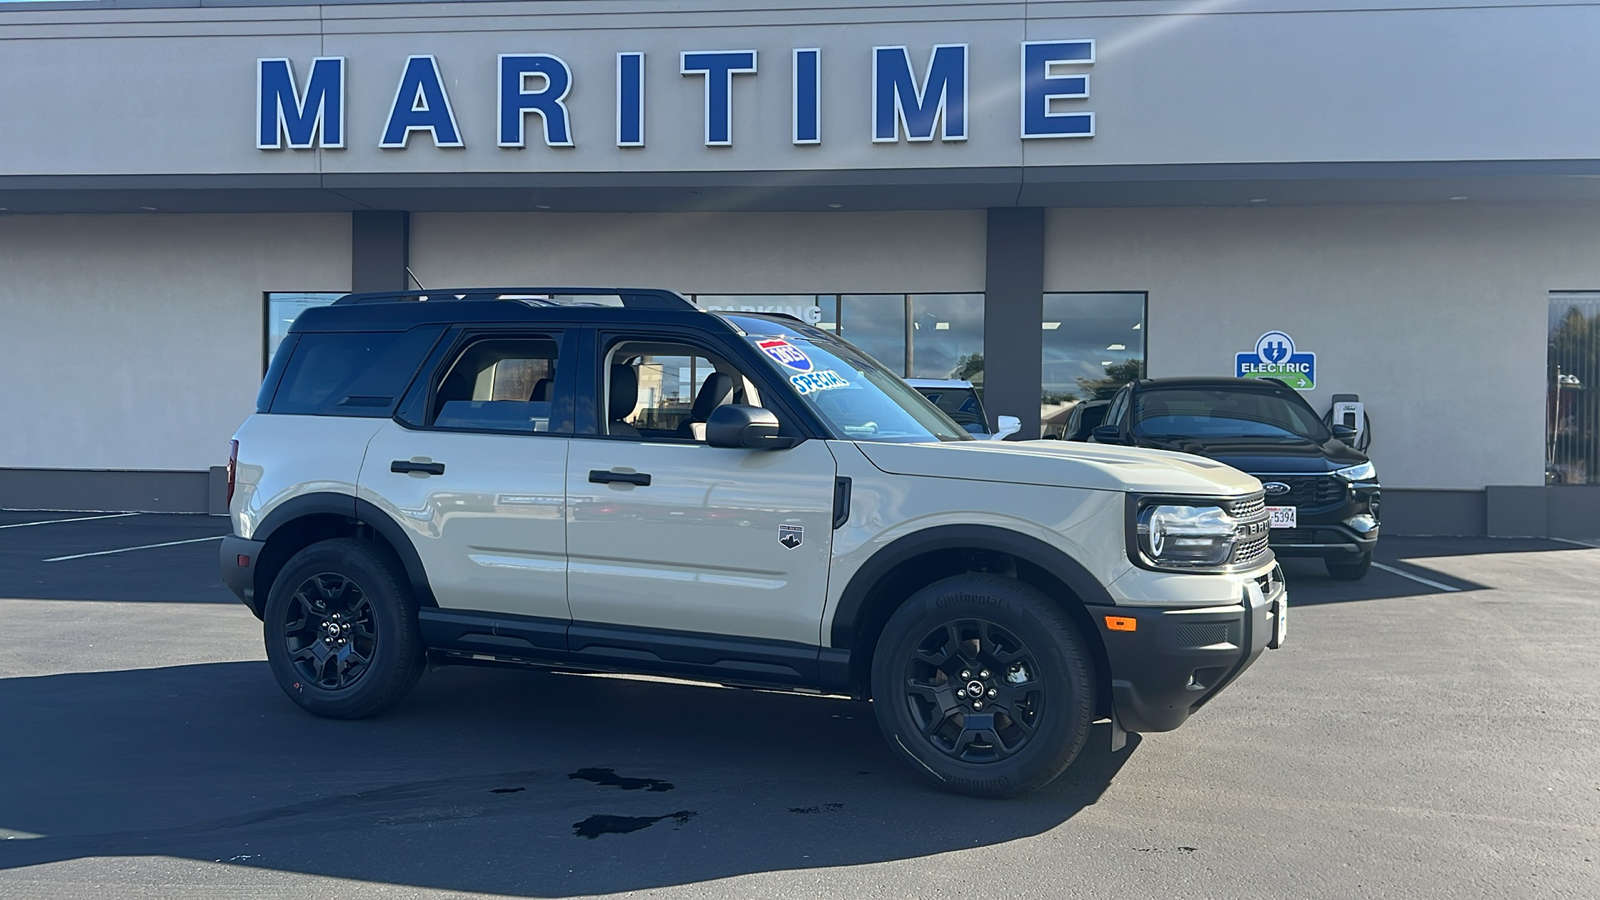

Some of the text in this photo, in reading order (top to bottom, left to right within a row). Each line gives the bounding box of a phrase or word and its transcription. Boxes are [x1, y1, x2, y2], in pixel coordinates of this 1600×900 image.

[256, 38, 1096, 151] MARITIME
[769, 346, 806, 363] 2025
[1241, 363, 1310, 373] ELECTRIC
[791, 370, 848, 394] SPECIAL
